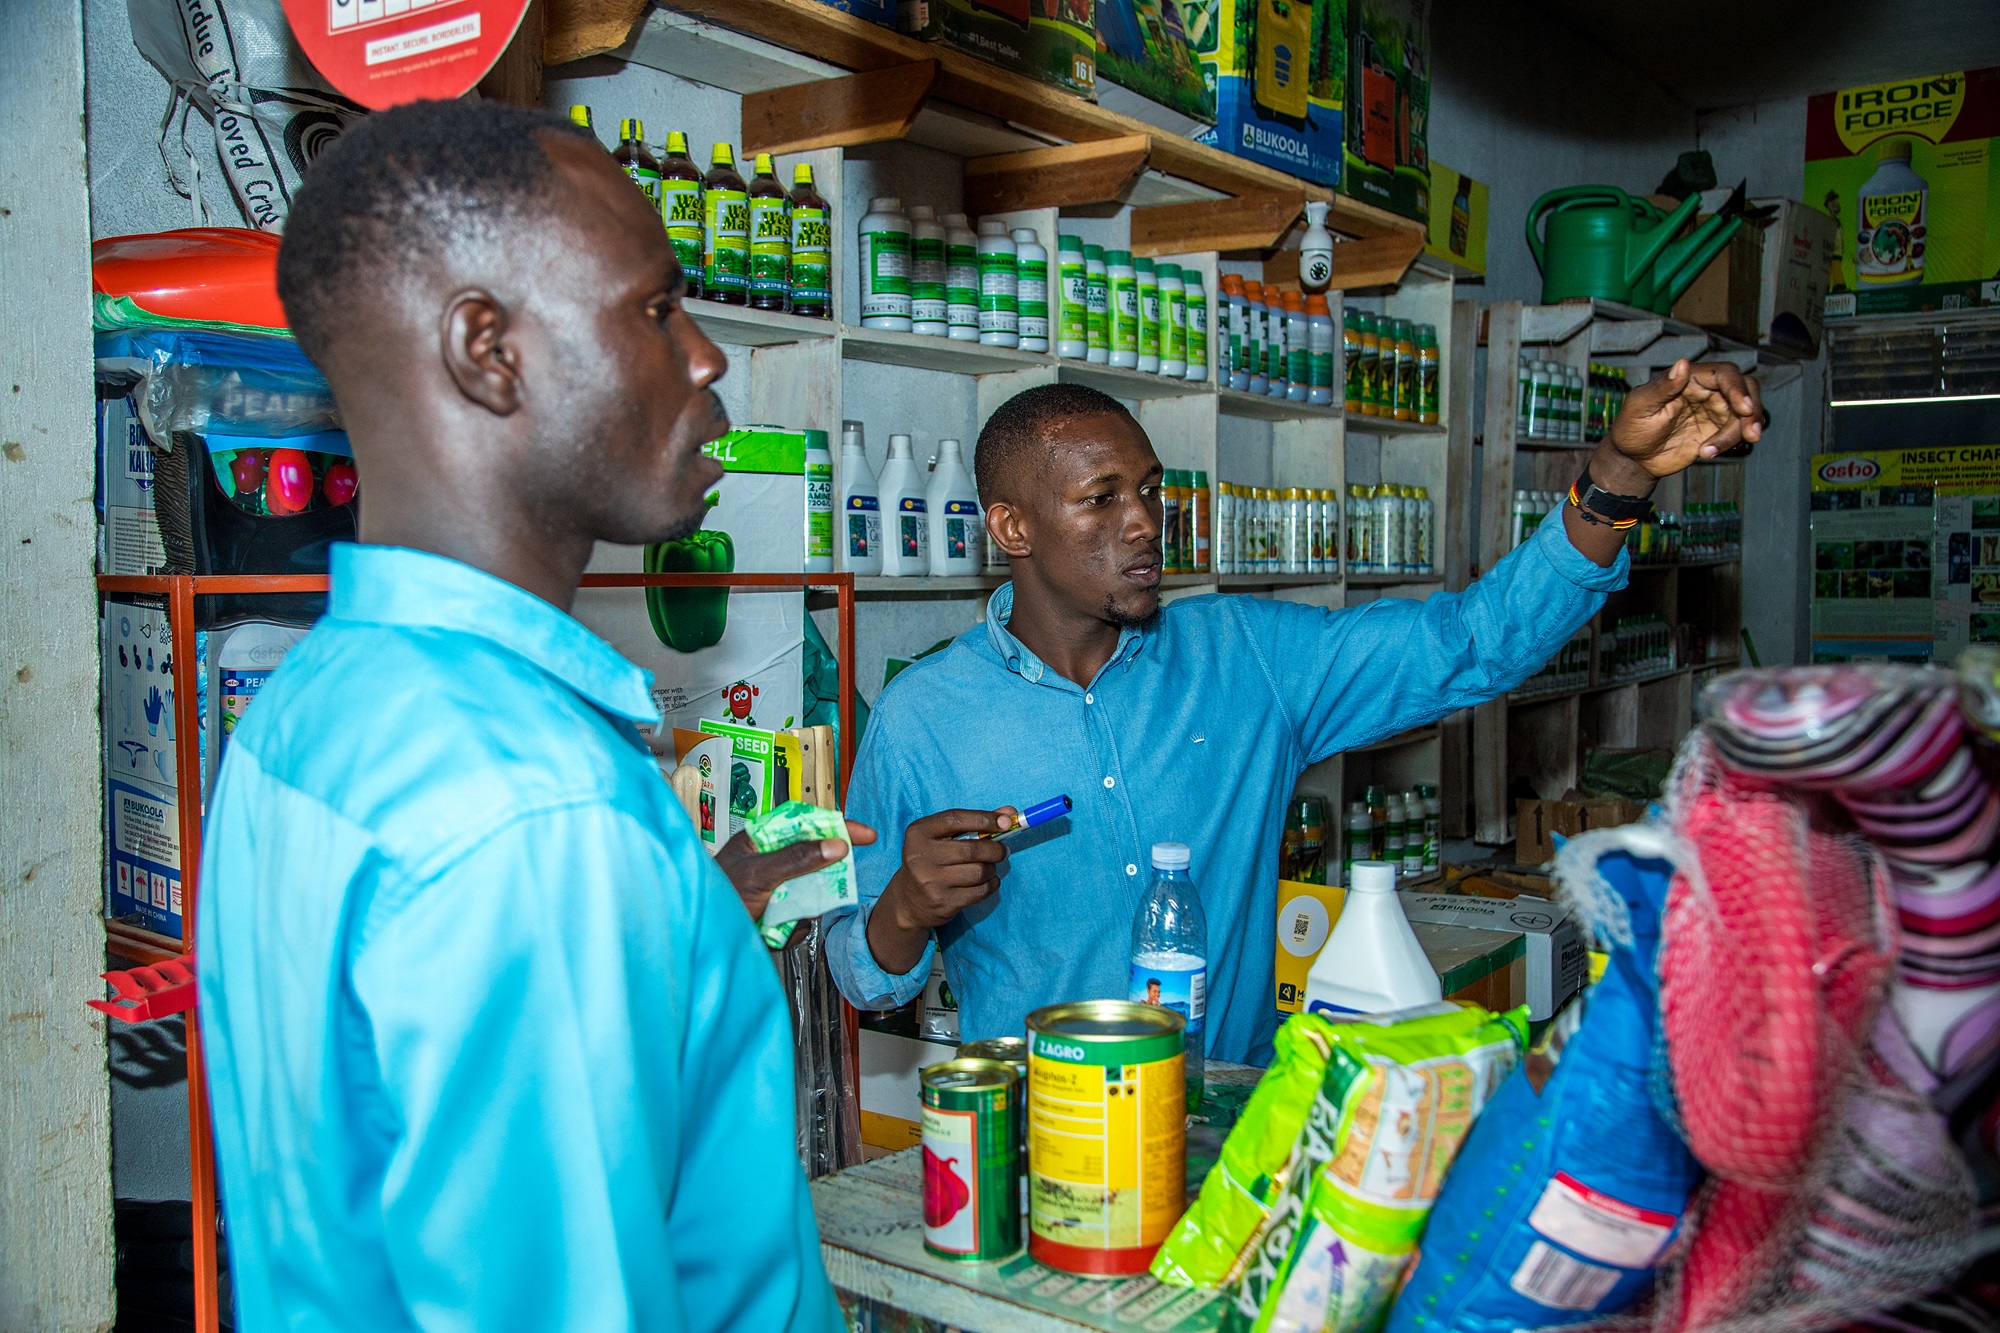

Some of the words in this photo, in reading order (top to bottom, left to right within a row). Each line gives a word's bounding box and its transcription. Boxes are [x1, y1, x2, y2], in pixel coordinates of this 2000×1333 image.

[1074, 60, 1087, 80] 16
[1842, 79, 1957, 111] IRON
[1845, 100, 1953, 130] FORCE
[1255, 127, 1310, 159] BUKOOLA
[1868, 194, 1918, 207] IRON
[1869, 204, 1916, 217] FORCE
[1901, 450, 1956, 464] INSECT
[808, 492, 832, 500] AMINE
[670, 686, 684, 694] with
[735, 736, 770, 755] SEED
[131, 800, 165, 819] BUKOOLA
[147, 909, 152, 917] IN
[152, 910, 167, 923] CHINA
[1446, 904, 1496, 915] BUKOOLA
[1039, 1040, 1085, 1061] ZAGRO
